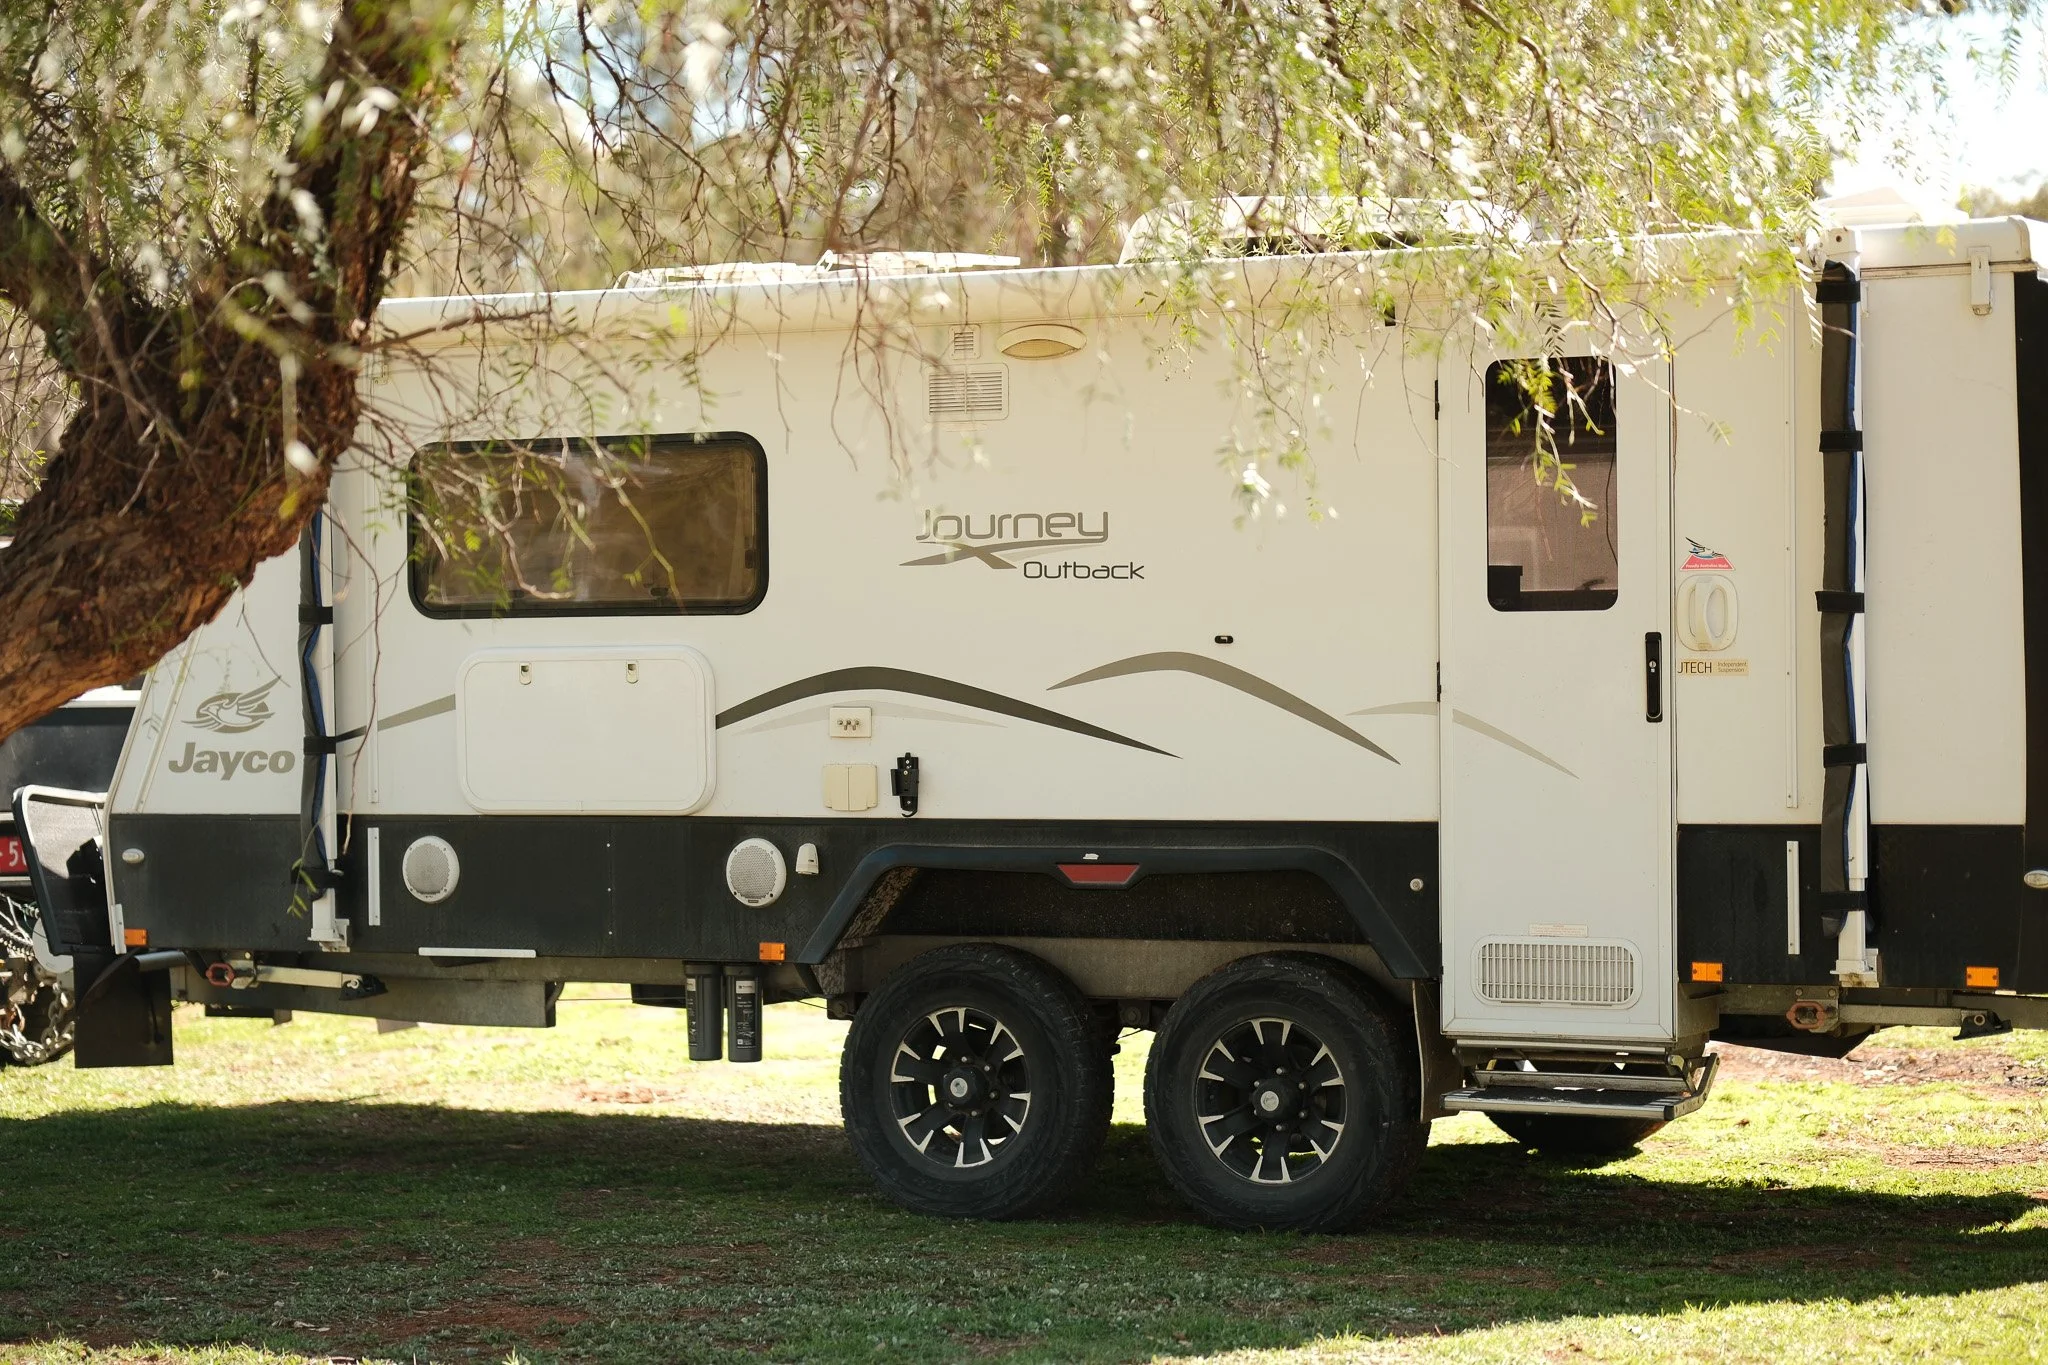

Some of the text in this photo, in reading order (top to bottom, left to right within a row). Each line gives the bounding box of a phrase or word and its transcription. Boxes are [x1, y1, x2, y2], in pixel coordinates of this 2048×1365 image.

[915, 509, 1109, 543] Journey
[1023, 561, 1145, 580] Outback
[1677, 661, 1712, 674] JTECH
[168, 742, 295, 781] Jayco
[8, 840, 28, 867] 5
